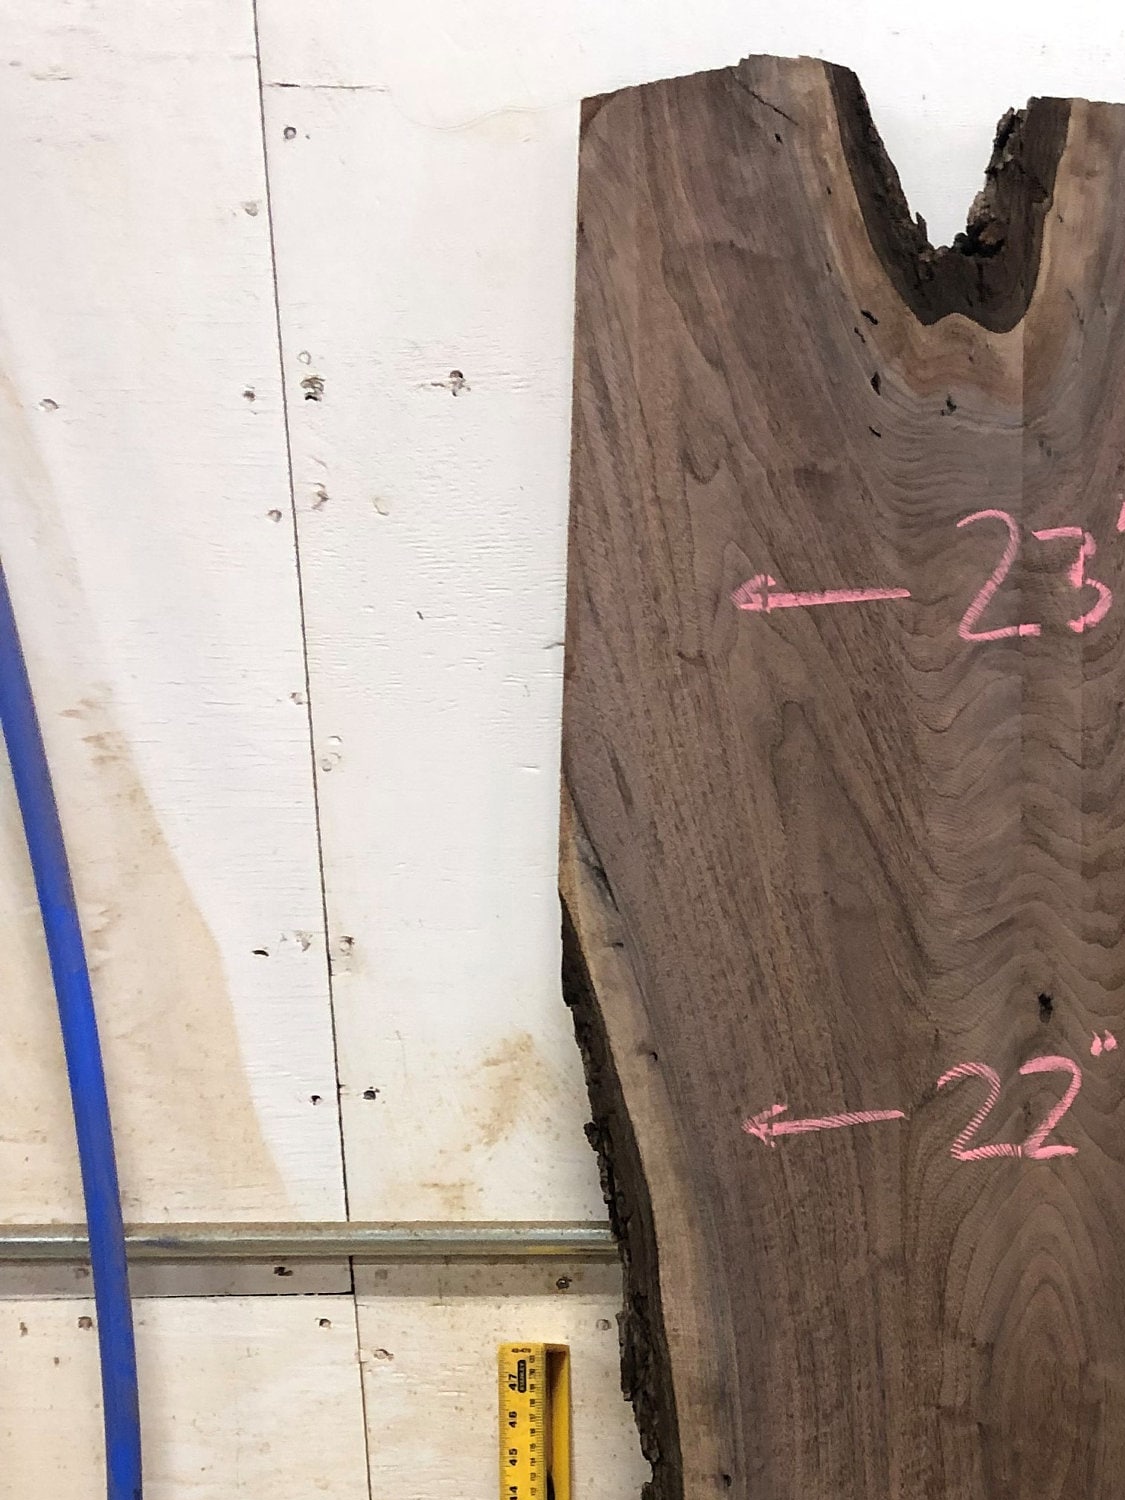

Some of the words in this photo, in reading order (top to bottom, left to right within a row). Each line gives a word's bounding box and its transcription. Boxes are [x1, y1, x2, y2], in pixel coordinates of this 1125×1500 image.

[936, 1029, 1119, 1161] 22"
[508, 1373, 517, 1391] 47
[508, 1411, 517, 1428] 46
[508, 1448, 518, 1466] 45
